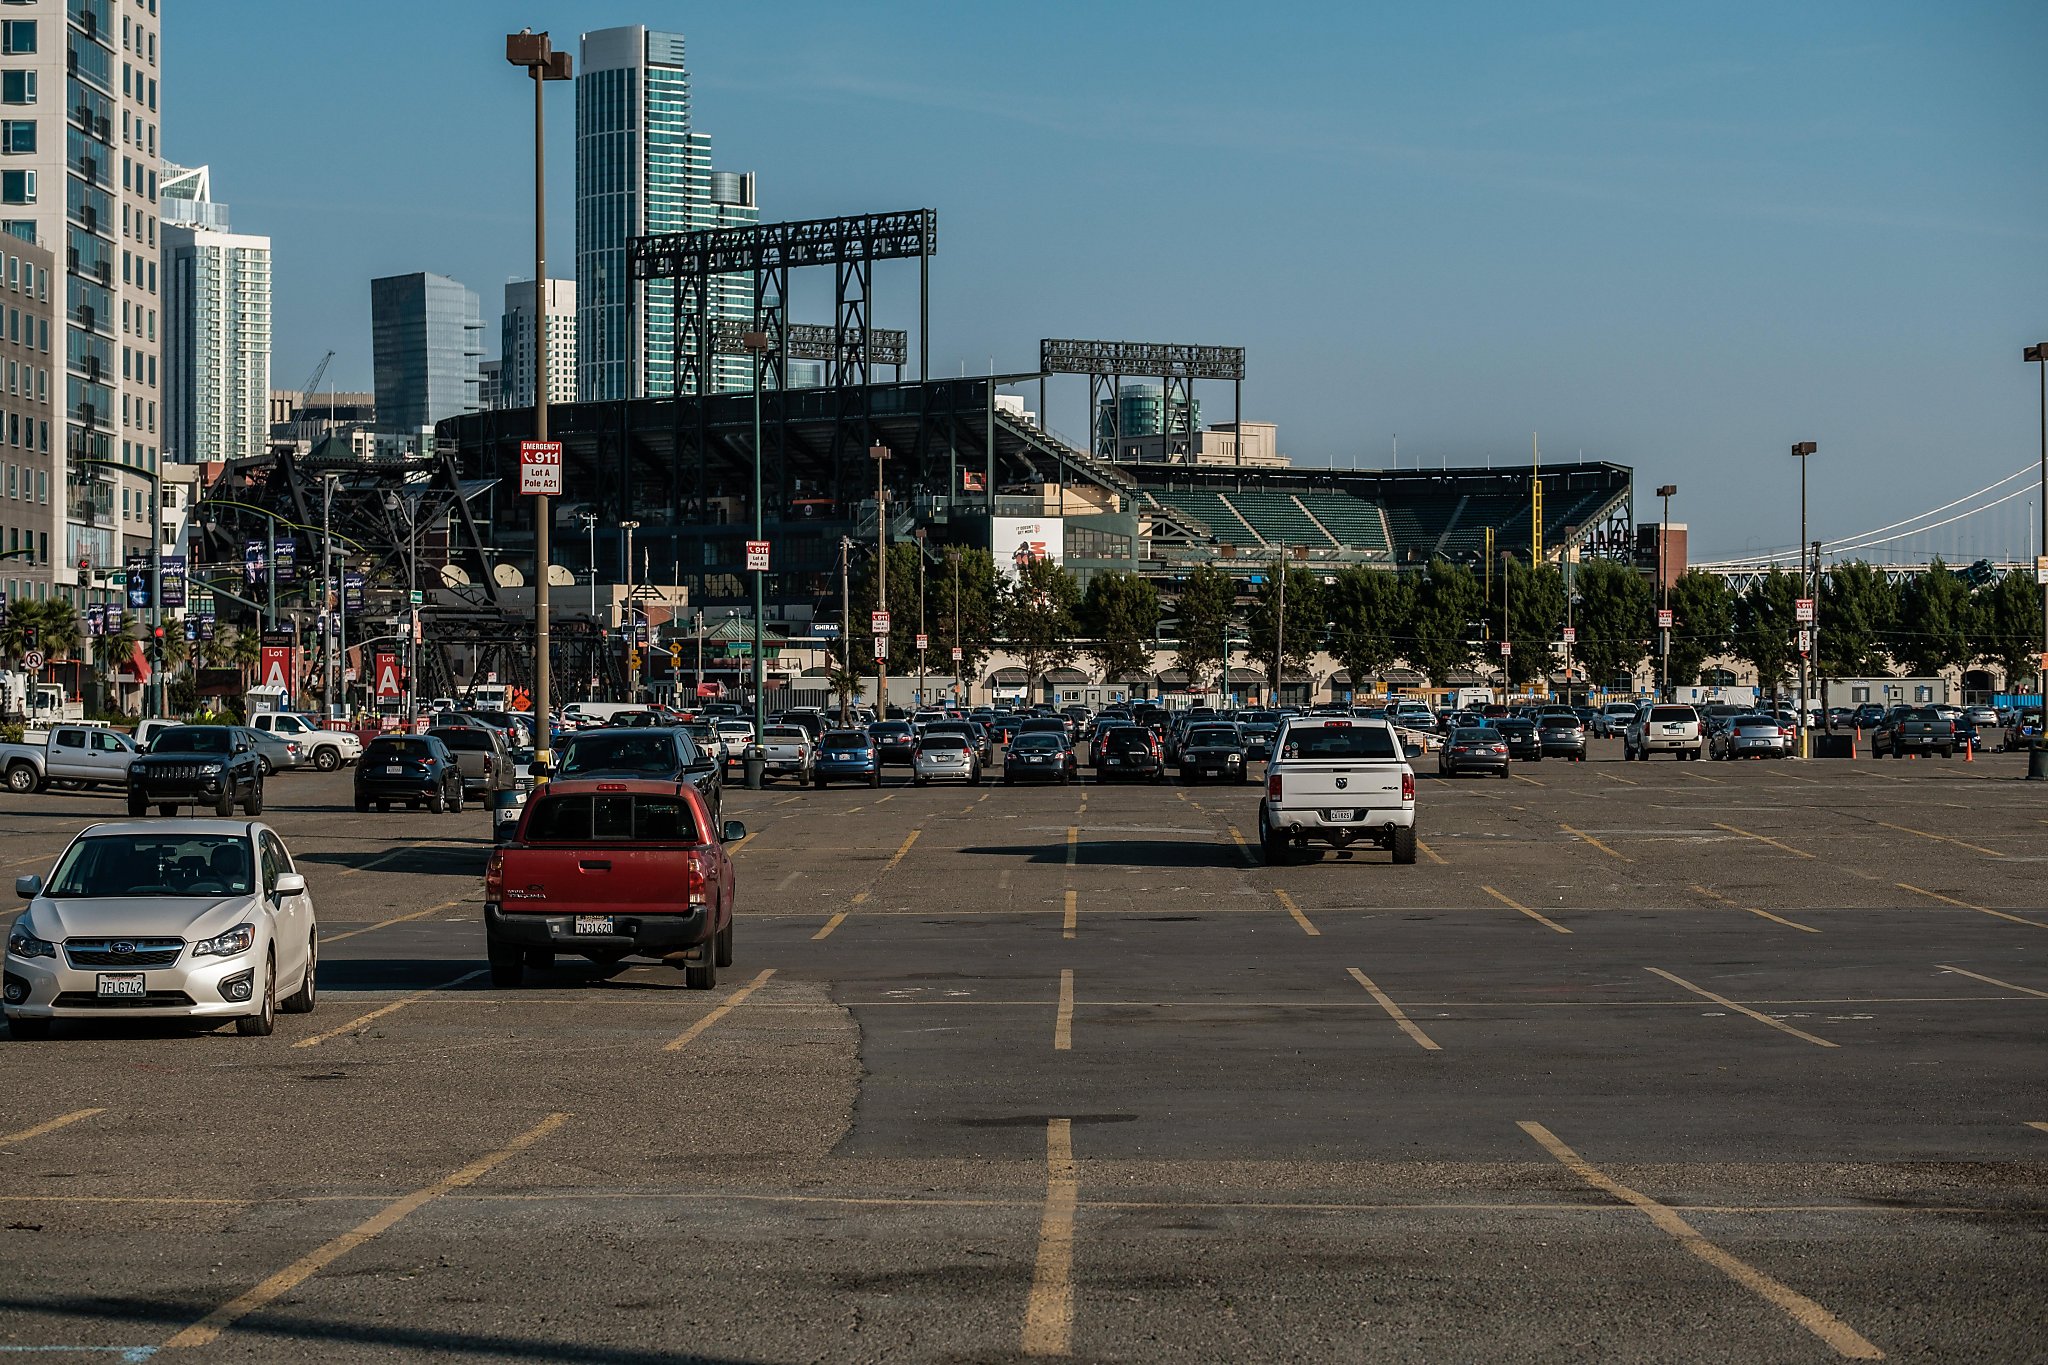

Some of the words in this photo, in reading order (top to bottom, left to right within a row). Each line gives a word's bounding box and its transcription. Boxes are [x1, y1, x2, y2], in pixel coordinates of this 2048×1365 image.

[535, 452, 559, 464] 911
[531, 469, 543, 477] Lot
[545, 469, 550, 477] A
[1801, 631, 1809, 651] EXIT
[268, 649, 283, 657] Lot
[876, 638, 885, 657] EXIT
[382, 655, 395, 663] Lot
[265, 661, 287, 688] A
[378, 665, 399, 694] A
[101, 981, 143, 993] 7FLG742
